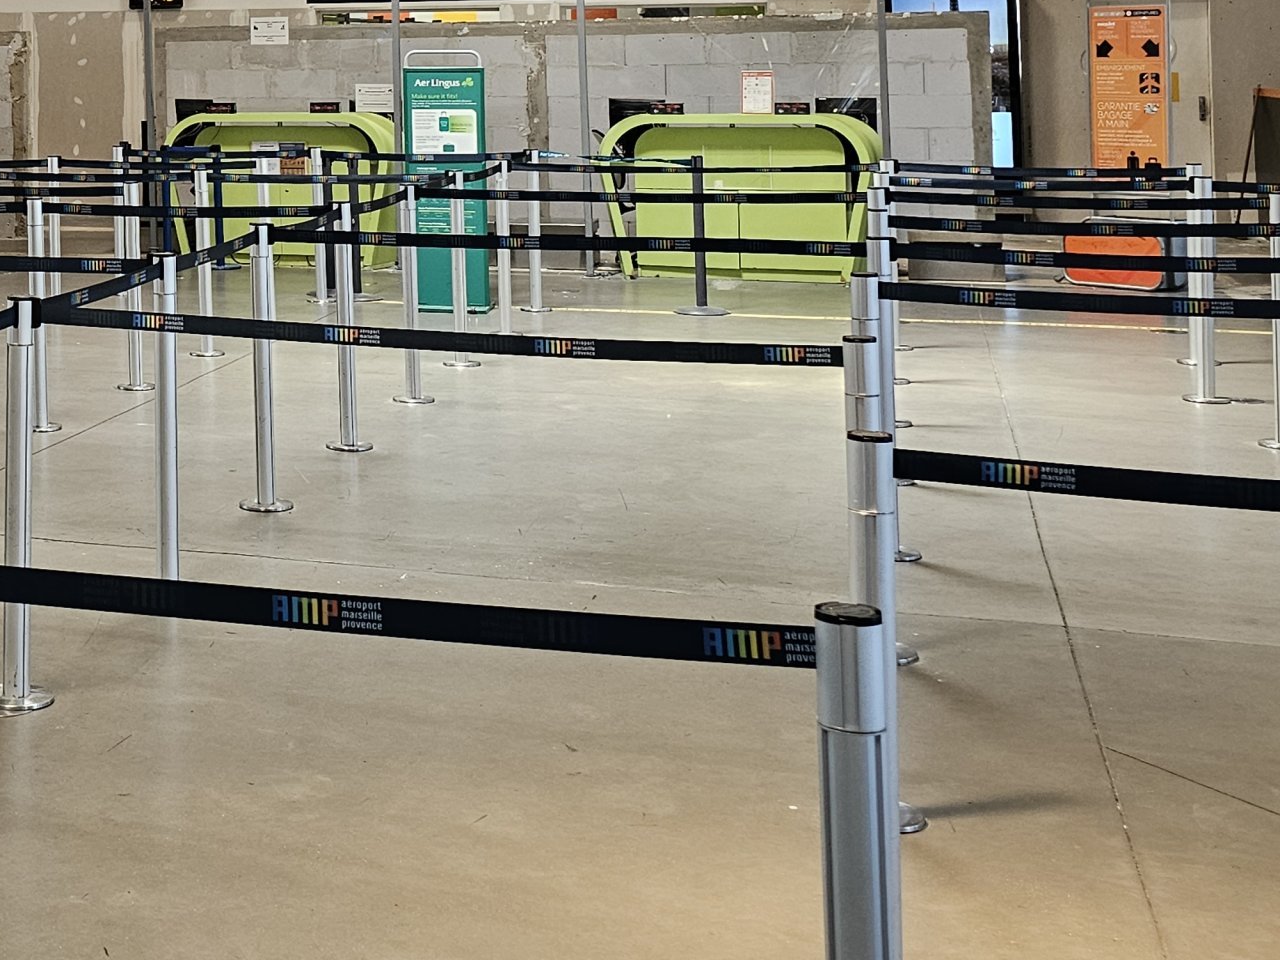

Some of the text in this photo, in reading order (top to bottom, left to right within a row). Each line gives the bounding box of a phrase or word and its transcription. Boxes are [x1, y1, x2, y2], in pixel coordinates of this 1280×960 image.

[414, 78, 460, 89] Aer Lingus
[1097, 101, 1140, 111] GARANTIE
[1097, 111, 1133, 119] BAGAGE
[1106, 120, 1129, 128] MAIN
[981, 461, 1039, 485] AMP
[272, 595, 338, 626] AMP
[703, 627, 781, 659] AMP
